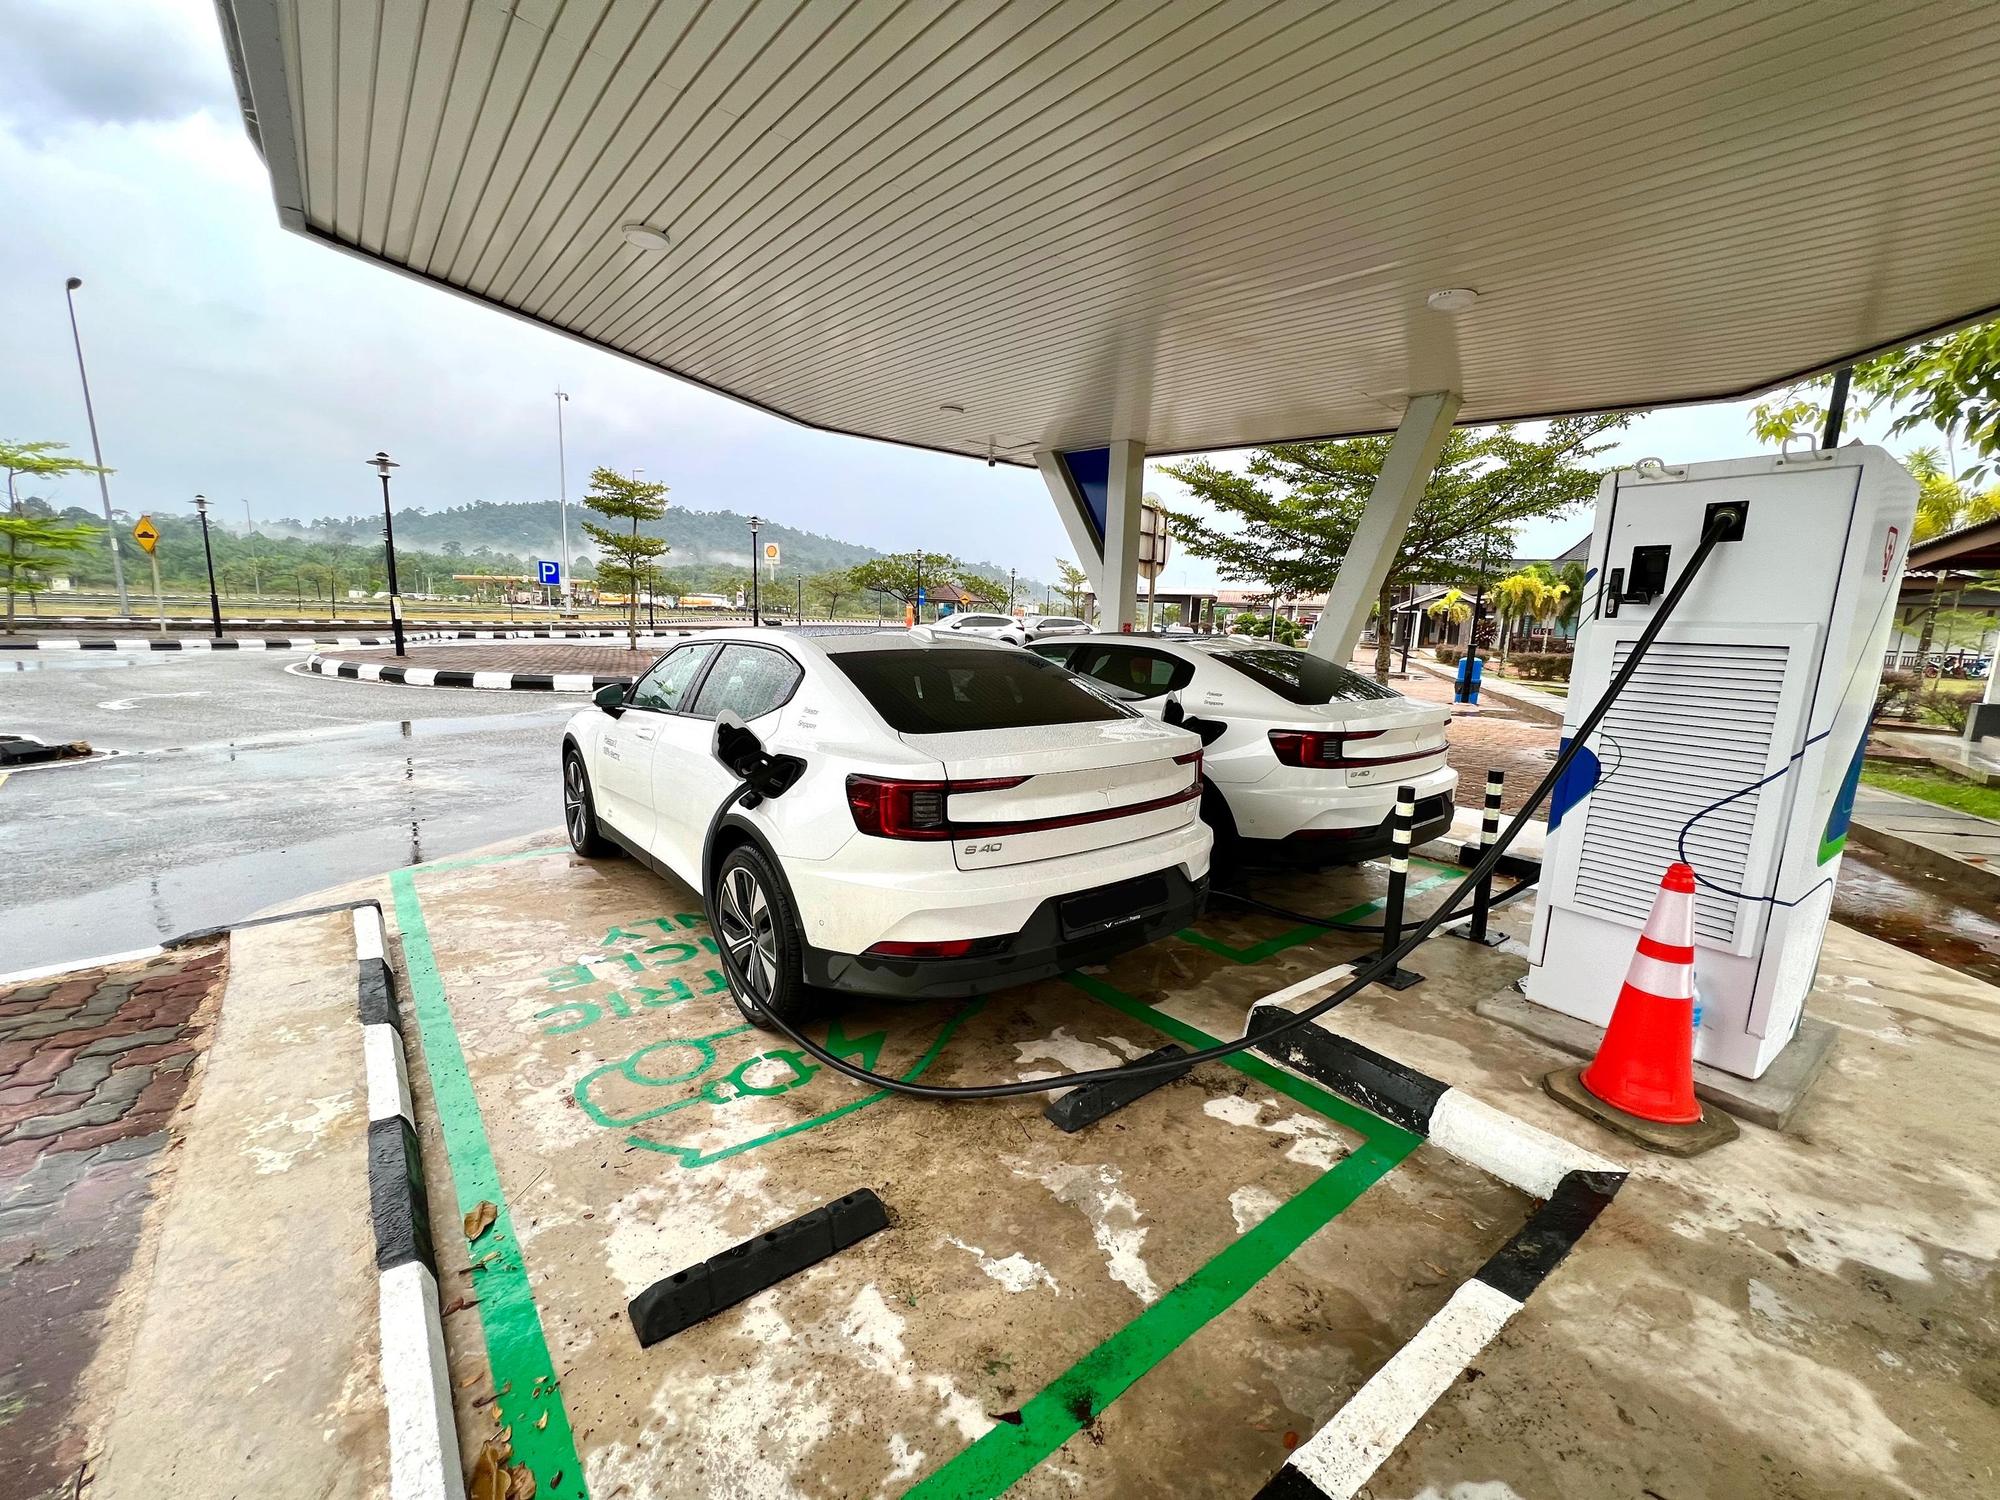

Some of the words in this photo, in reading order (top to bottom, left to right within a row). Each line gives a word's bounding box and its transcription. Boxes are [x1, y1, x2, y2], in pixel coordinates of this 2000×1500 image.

[542, 563, 556, 582] P
[540, 936, 721, 991] ICLE
[534, 969, 729, 1035] TRIC
